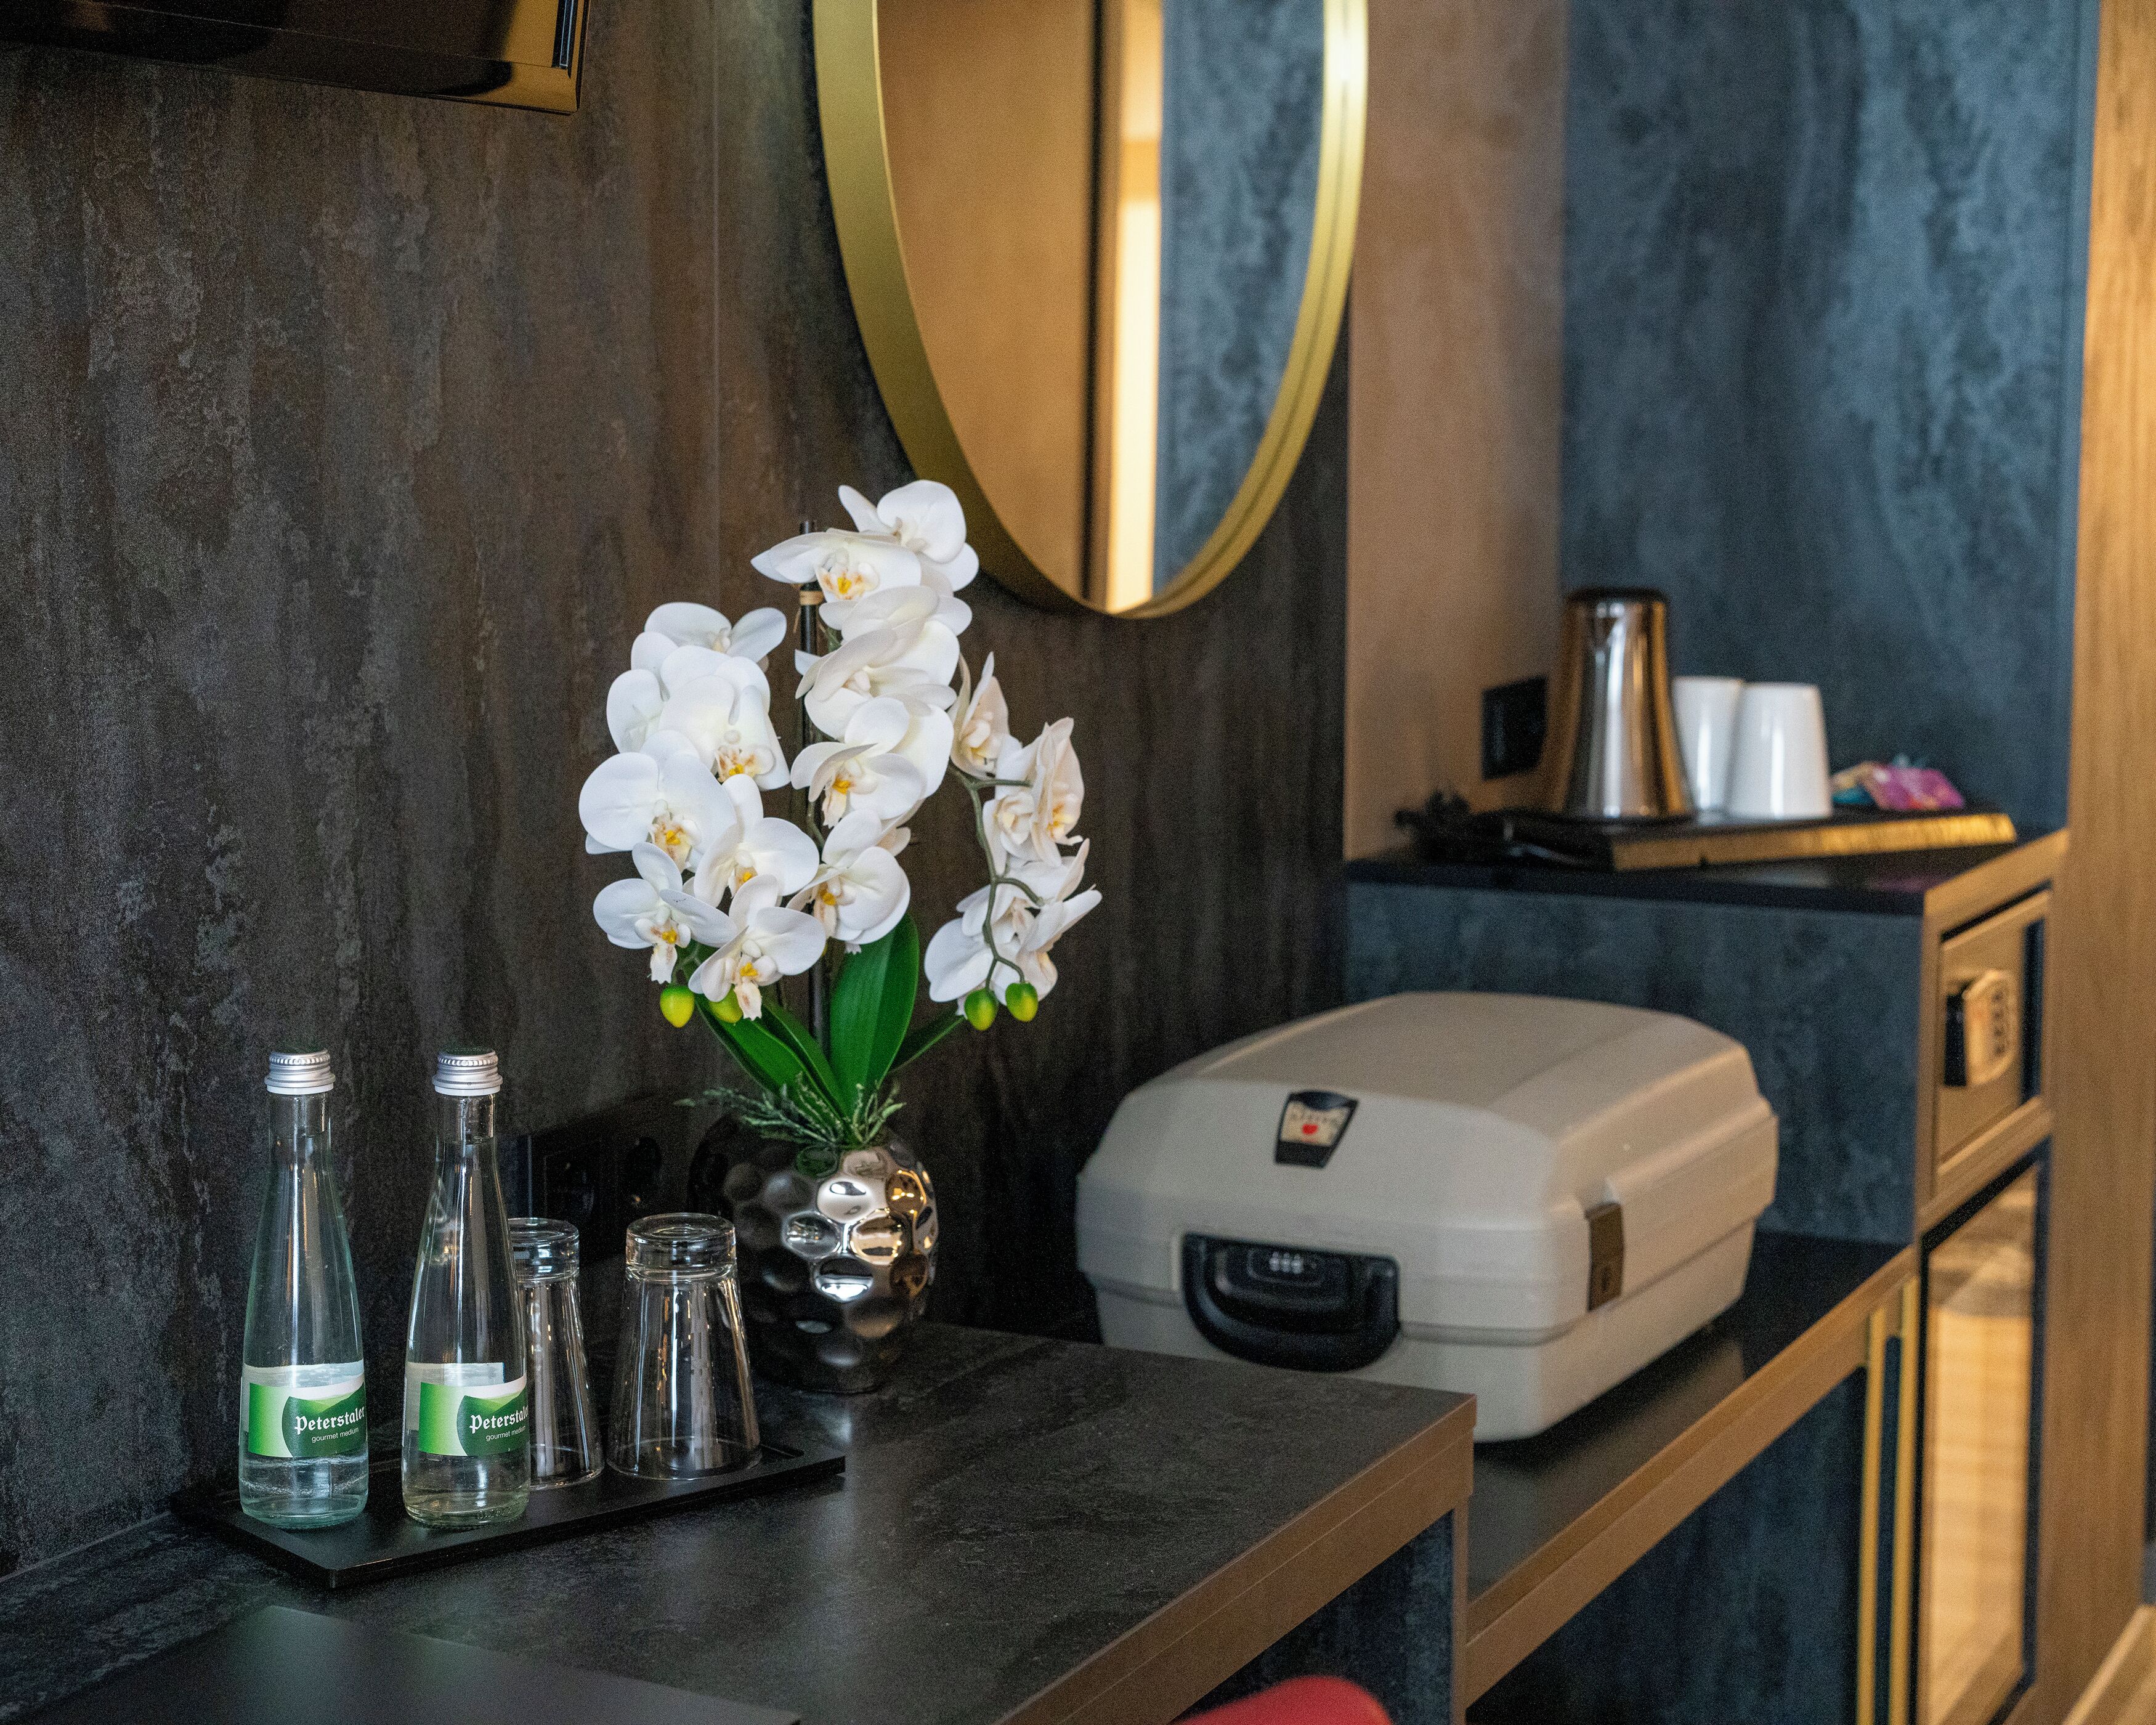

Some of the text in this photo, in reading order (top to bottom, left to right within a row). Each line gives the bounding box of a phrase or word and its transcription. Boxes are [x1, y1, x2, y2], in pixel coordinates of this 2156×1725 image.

[294, 1406, 365, 1435] Peterstaler
[311, 1427, 359, 1443] gourmet medium
[485, 1431, 511, 1442] gourmet
